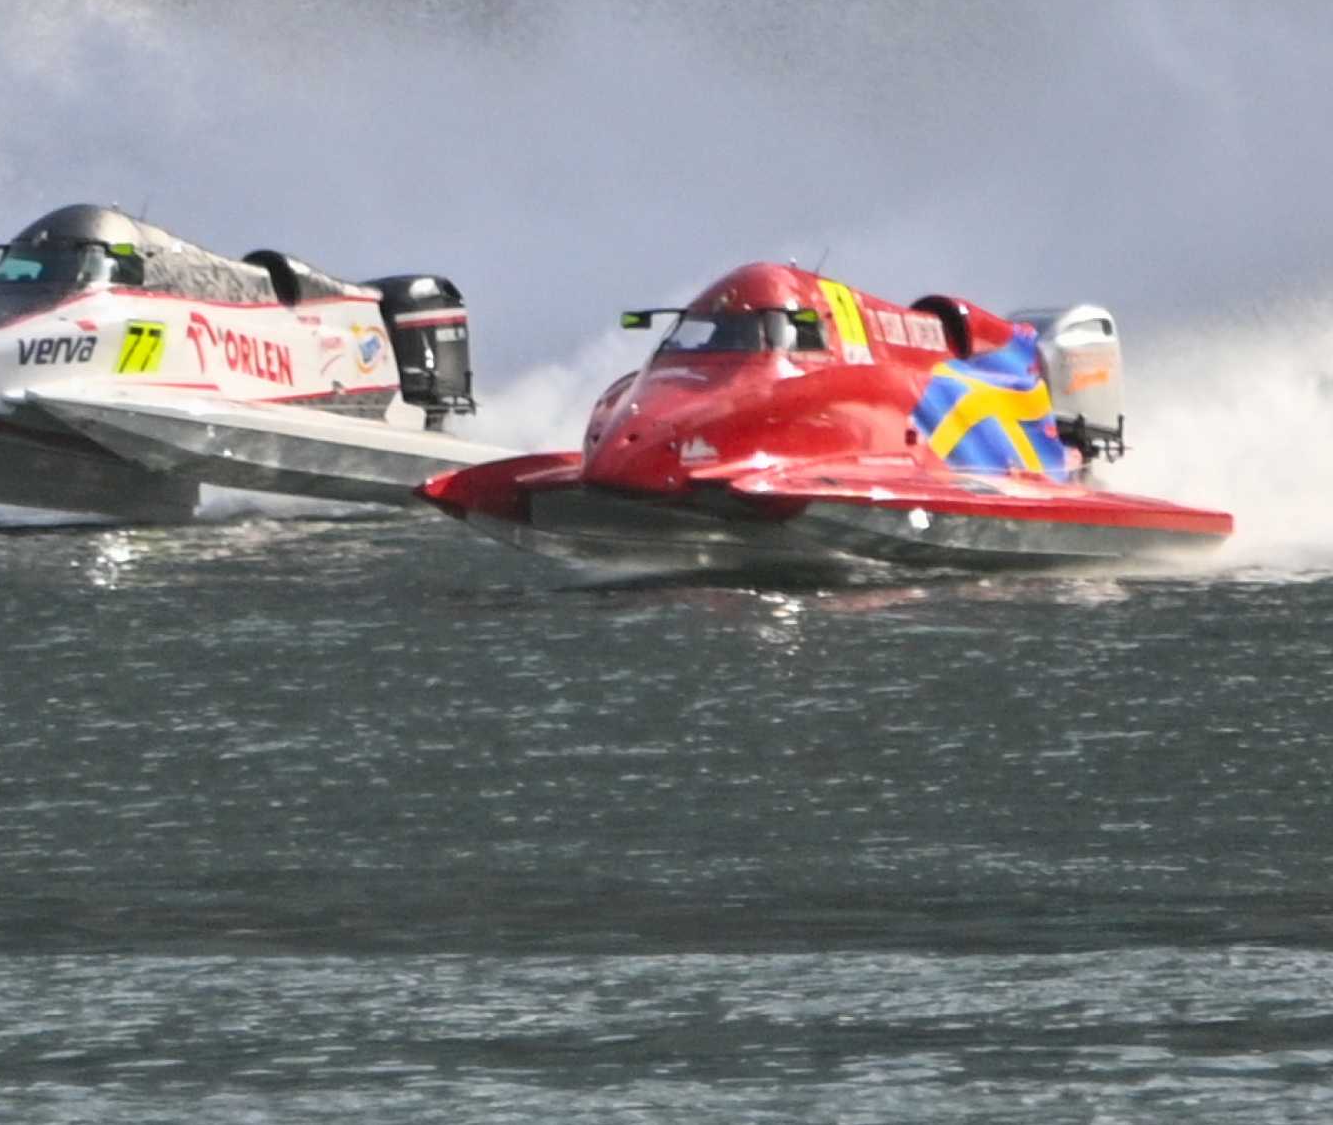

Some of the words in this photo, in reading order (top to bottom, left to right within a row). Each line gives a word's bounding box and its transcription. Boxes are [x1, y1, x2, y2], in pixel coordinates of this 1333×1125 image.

[17, 335, 98, 366] verva
[119, 326, 163, 374] 77
[225, 329, 294, 388] ORLEN
